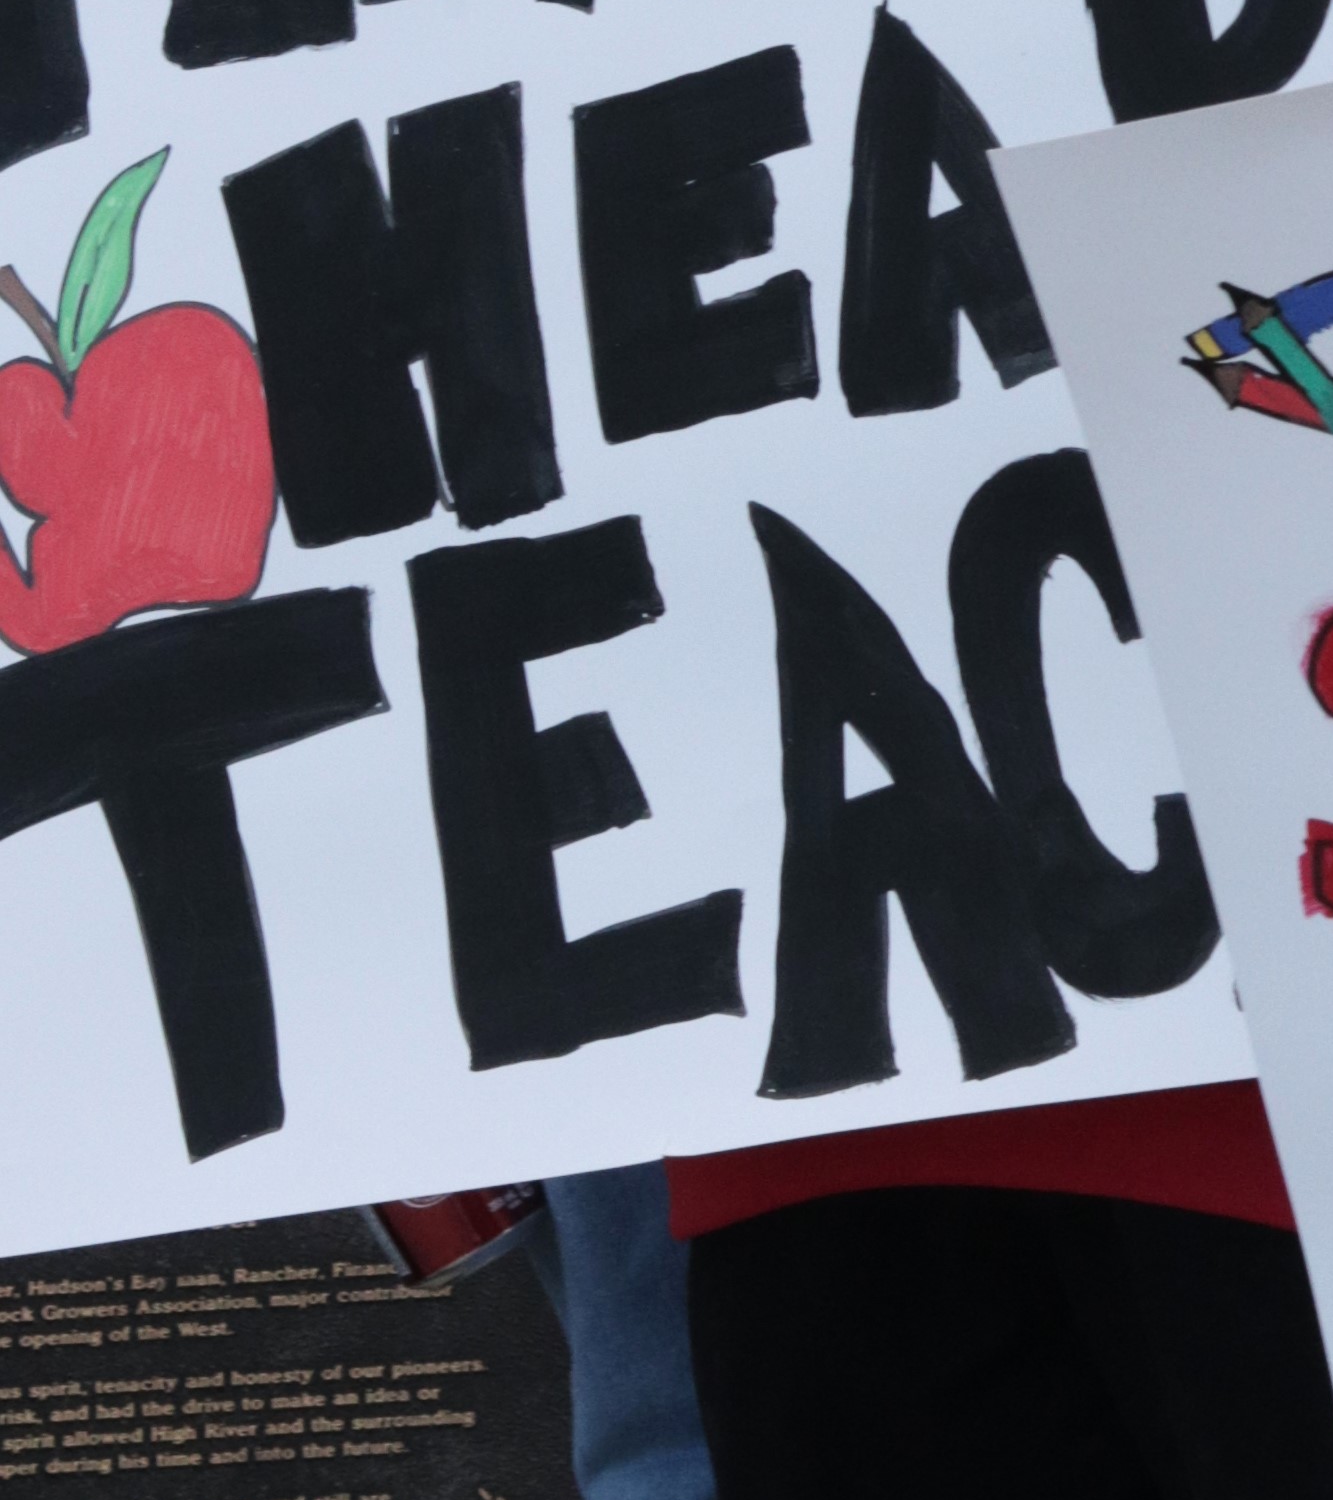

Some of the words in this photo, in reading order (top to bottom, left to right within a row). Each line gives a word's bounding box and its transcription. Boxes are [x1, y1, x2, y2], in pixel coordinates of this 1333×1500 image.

[27, 1276, 125, 1296] Hudson's
[233, 1266, 325, 1284] Rancher,
[41, 1304, 129, 1321] Growers
[269, 1292, 330, 1308] major
[18, 1329, 103, 1349] opening
[108, 1326, 131, 1342] of
[137, 1325, 170, 1341] the
[178, 1322, 235, 1337] West.
[95, 1376, 178, 1394] tenacity
[185, 1371, 224, 1389] and
[230, 1369, 314, 1386] honesty
[321, 1364, 342, 1380] of
[349, 1365, 385, 1379] our
[391, 1359, 489, 1380] pioneers.
[50, 1405, 89, 1422] and
[96, 1402, 135, 1419] had
[142, 1400, 175, 1417] the
[182, 1397, 236, 1414] drive
[242, 1396, 265, 1411] to
[270, 1392, 326, 1409] make
[332, 1392, 359, 1406] an
[365, 1387, 411, 1404] idea
[416, 1387, 441, 1401] or
[3, 1433, 55, 1453] spirit
[62, 1427, 144, 1447] allowed
[151, 1424, 197, 1444] High
[204, 1421, 257, 1438] River
[265, 1417, 304, 1435] and
[311, 1415, 345, 1432] the
[352, 1409, 476, 1430] surrounding
[45, 1456, 112, 1474] during
[118, 1453, 149, 1469] his
[156, 1452, 203, 1468] time
[209, 1447, 248, 1465] and
[255, 1446, 296, 1462] into
[303, 1443, 336, 1459] the
[342, 1440, 410, 1456] future.
